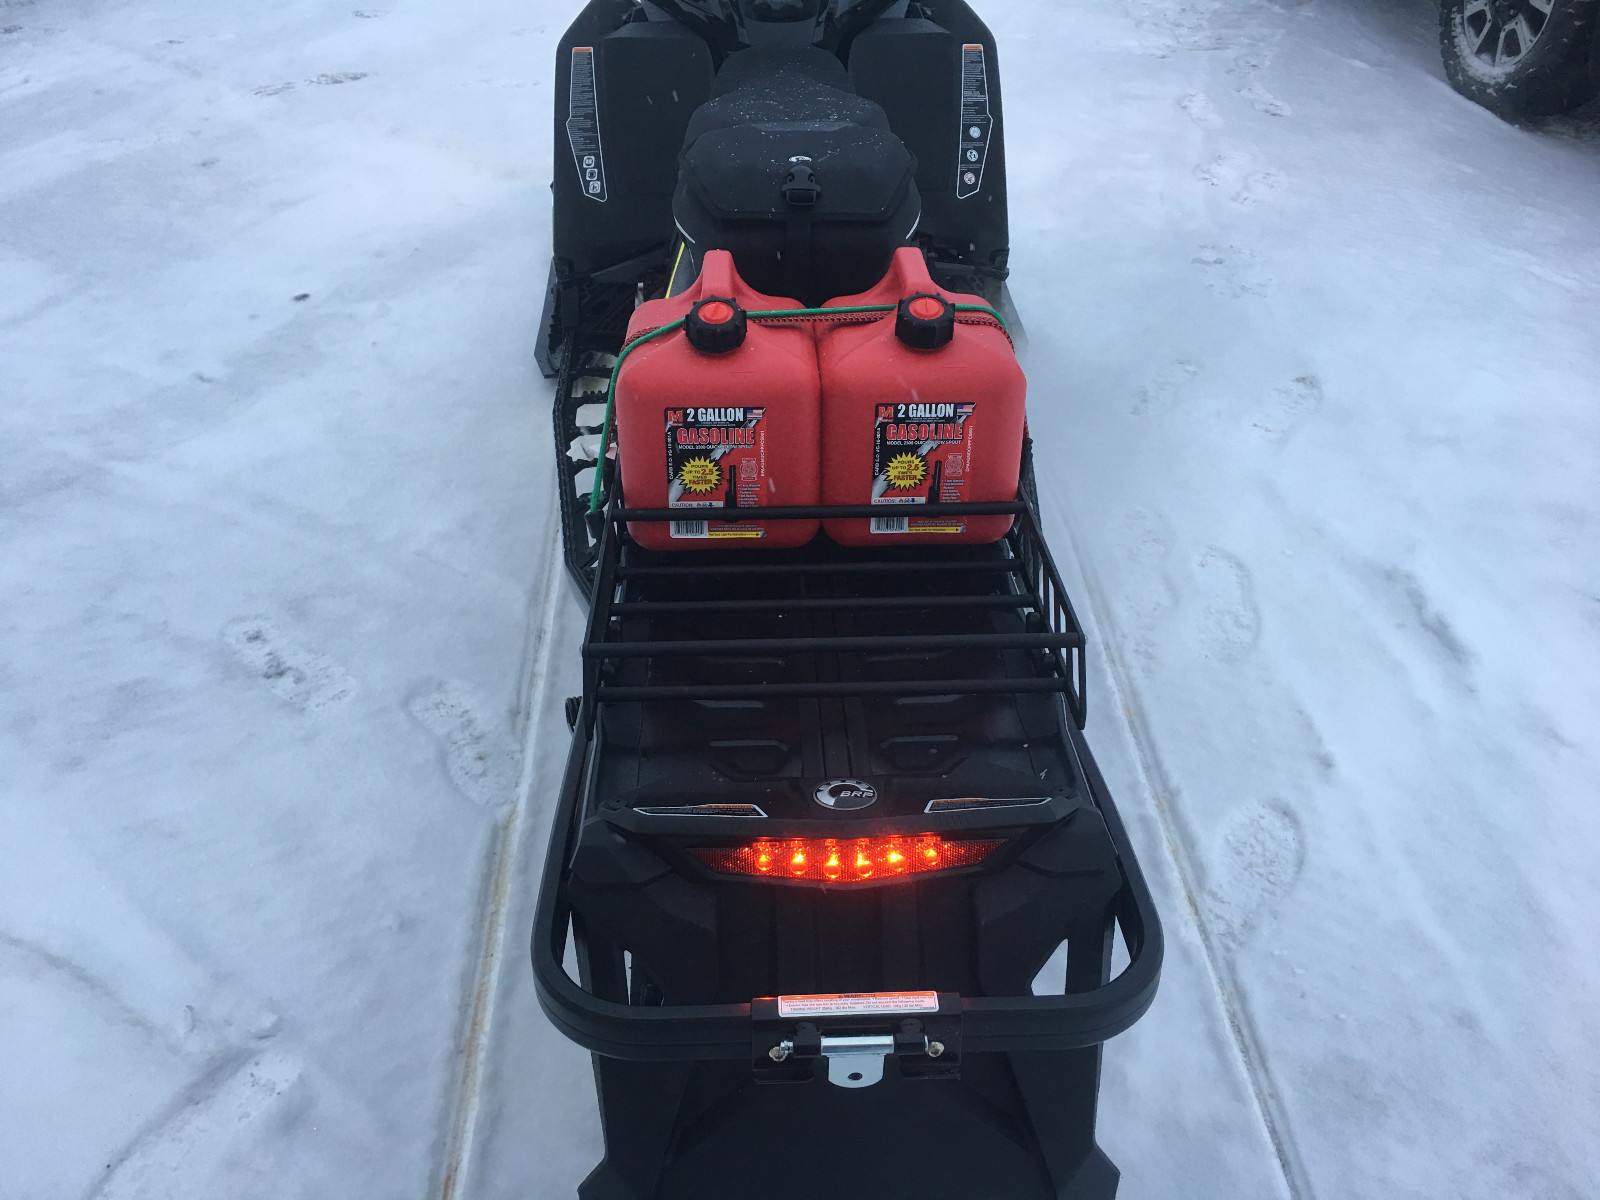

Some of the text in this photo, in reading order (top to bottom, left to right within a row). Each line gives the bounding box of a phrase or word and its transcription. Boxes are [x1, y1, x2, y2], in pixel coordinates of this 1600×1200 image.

[686, 408, 744, 422] 2 GALLON
[898, 404, 954, 418] 2 GALLON
[677, 428, 755, 444] GASOLINE
[886, 424, 962, 440] GASOLINE
